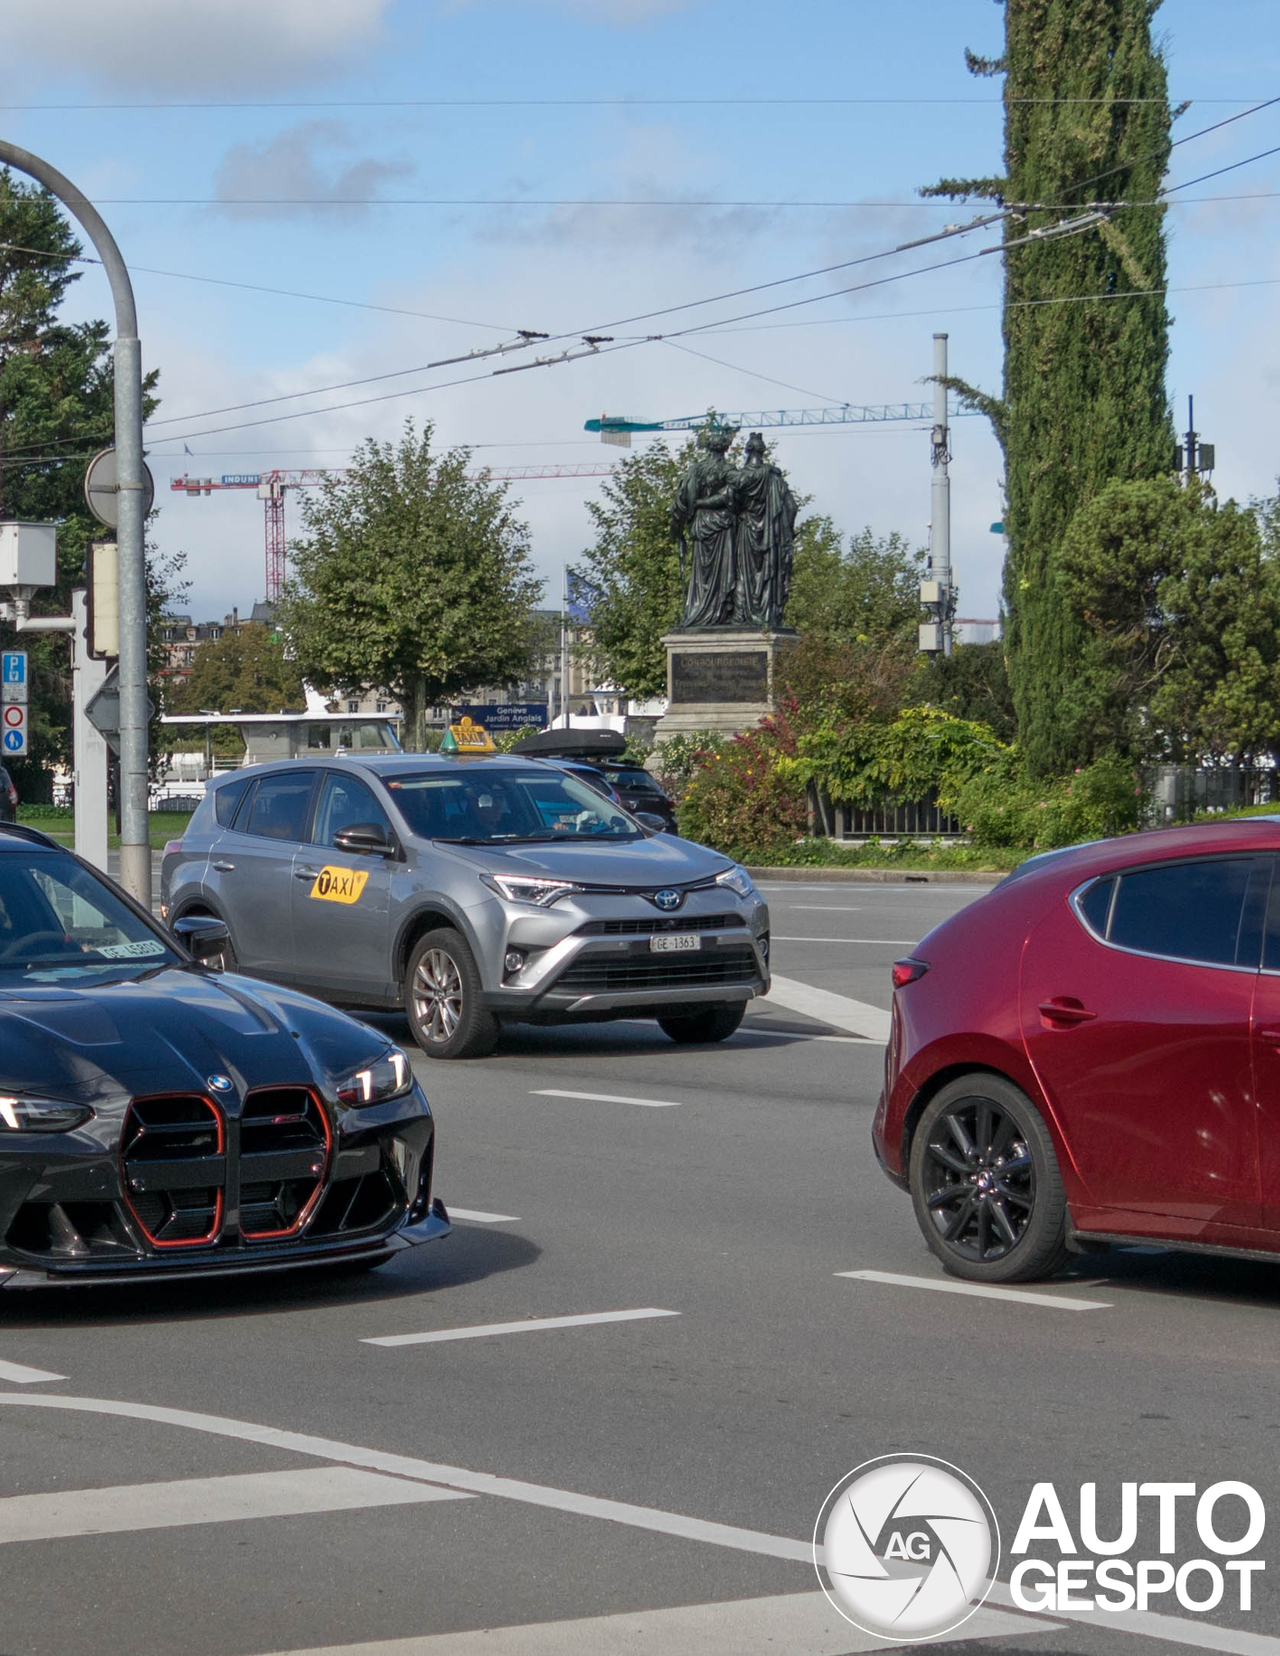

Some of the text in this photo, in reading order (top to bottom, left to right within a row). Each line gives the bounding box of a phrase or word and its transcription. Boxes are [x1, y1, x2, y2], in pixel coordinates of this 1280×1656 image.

[10, 656, 19, 670] P
[496, 706, 527, 715] Genève
[484, 715, 542, 724] Jardin Anglais
[320, 872, 355, 896] TAXI
[657, 937, 668, 950] GE
